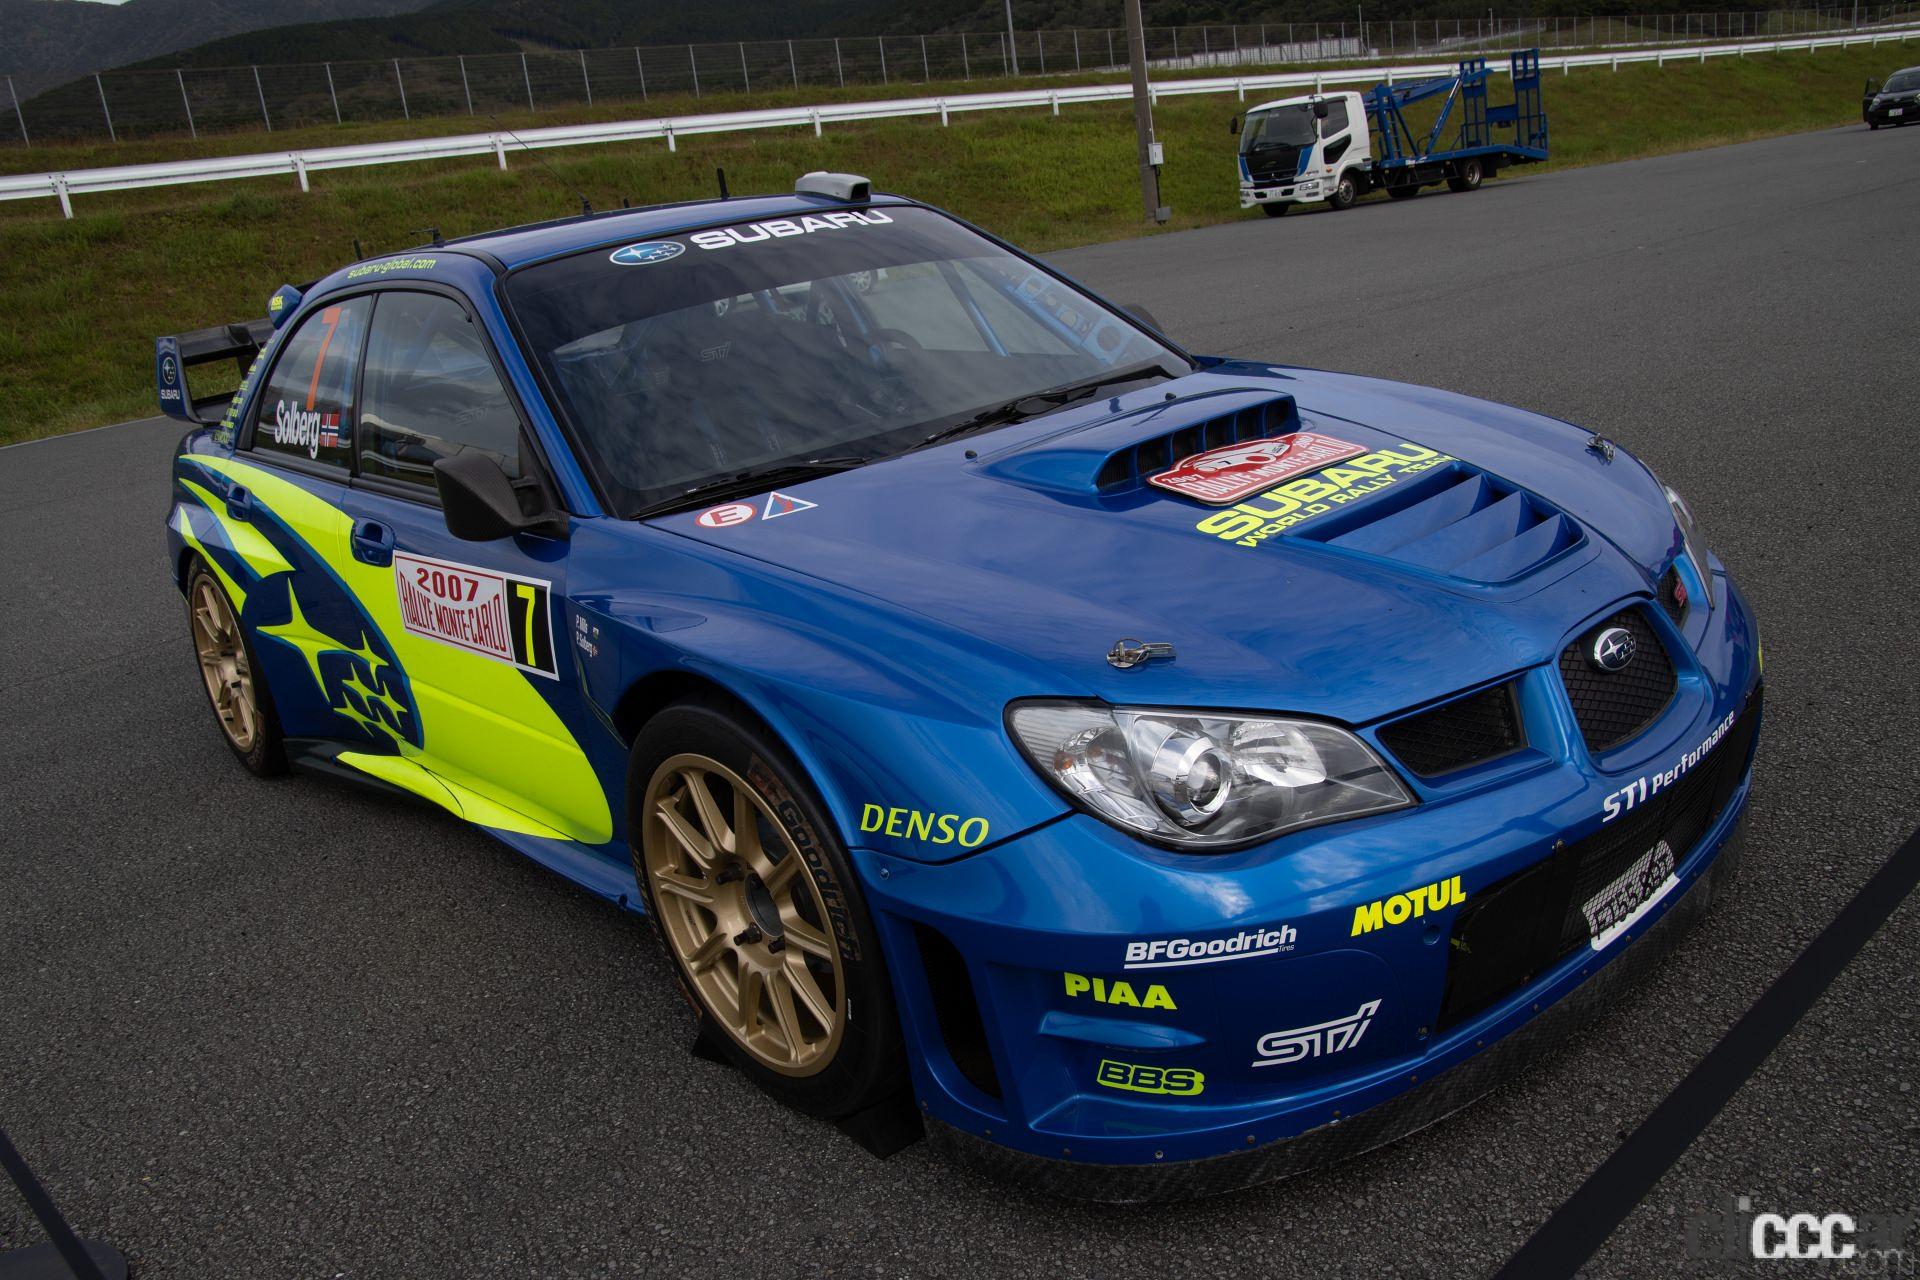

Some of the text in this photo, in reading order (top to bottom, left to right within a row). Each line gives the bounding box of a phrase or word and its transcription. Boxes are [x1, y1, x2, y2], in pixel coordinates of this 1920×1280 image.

[690, 209, 894, 251] SUBARU
[347, 257, 437, 279] subaru-global.com
[306, 307, 341, 412] 7
[160, 389, 181, 400] SUBARU
[274, 399, 320, 460] Solberg
[1195, 443, 1439, 541] SUBARU
[1235, 453, 1459, 548] WORLD RALLY TEAM
[416, 567, 479, 603] 2007
[399, 570, 507, 653] RALLYE MONTE-CARLO
[516, 583, 537, 667] 7
[1651, 709, 1736, 795] Performance
[860, 803, 990, 848] DENSO
[1350, 875, 1467, 937] MOTUL
[1124, 924, 1297, 963] BFGoodrich
[1278, 944, 1295, 954] Tires
[1064, 972, 1177, 1010] PIAA
[1097, 1059, 1205, 1096] BBS
